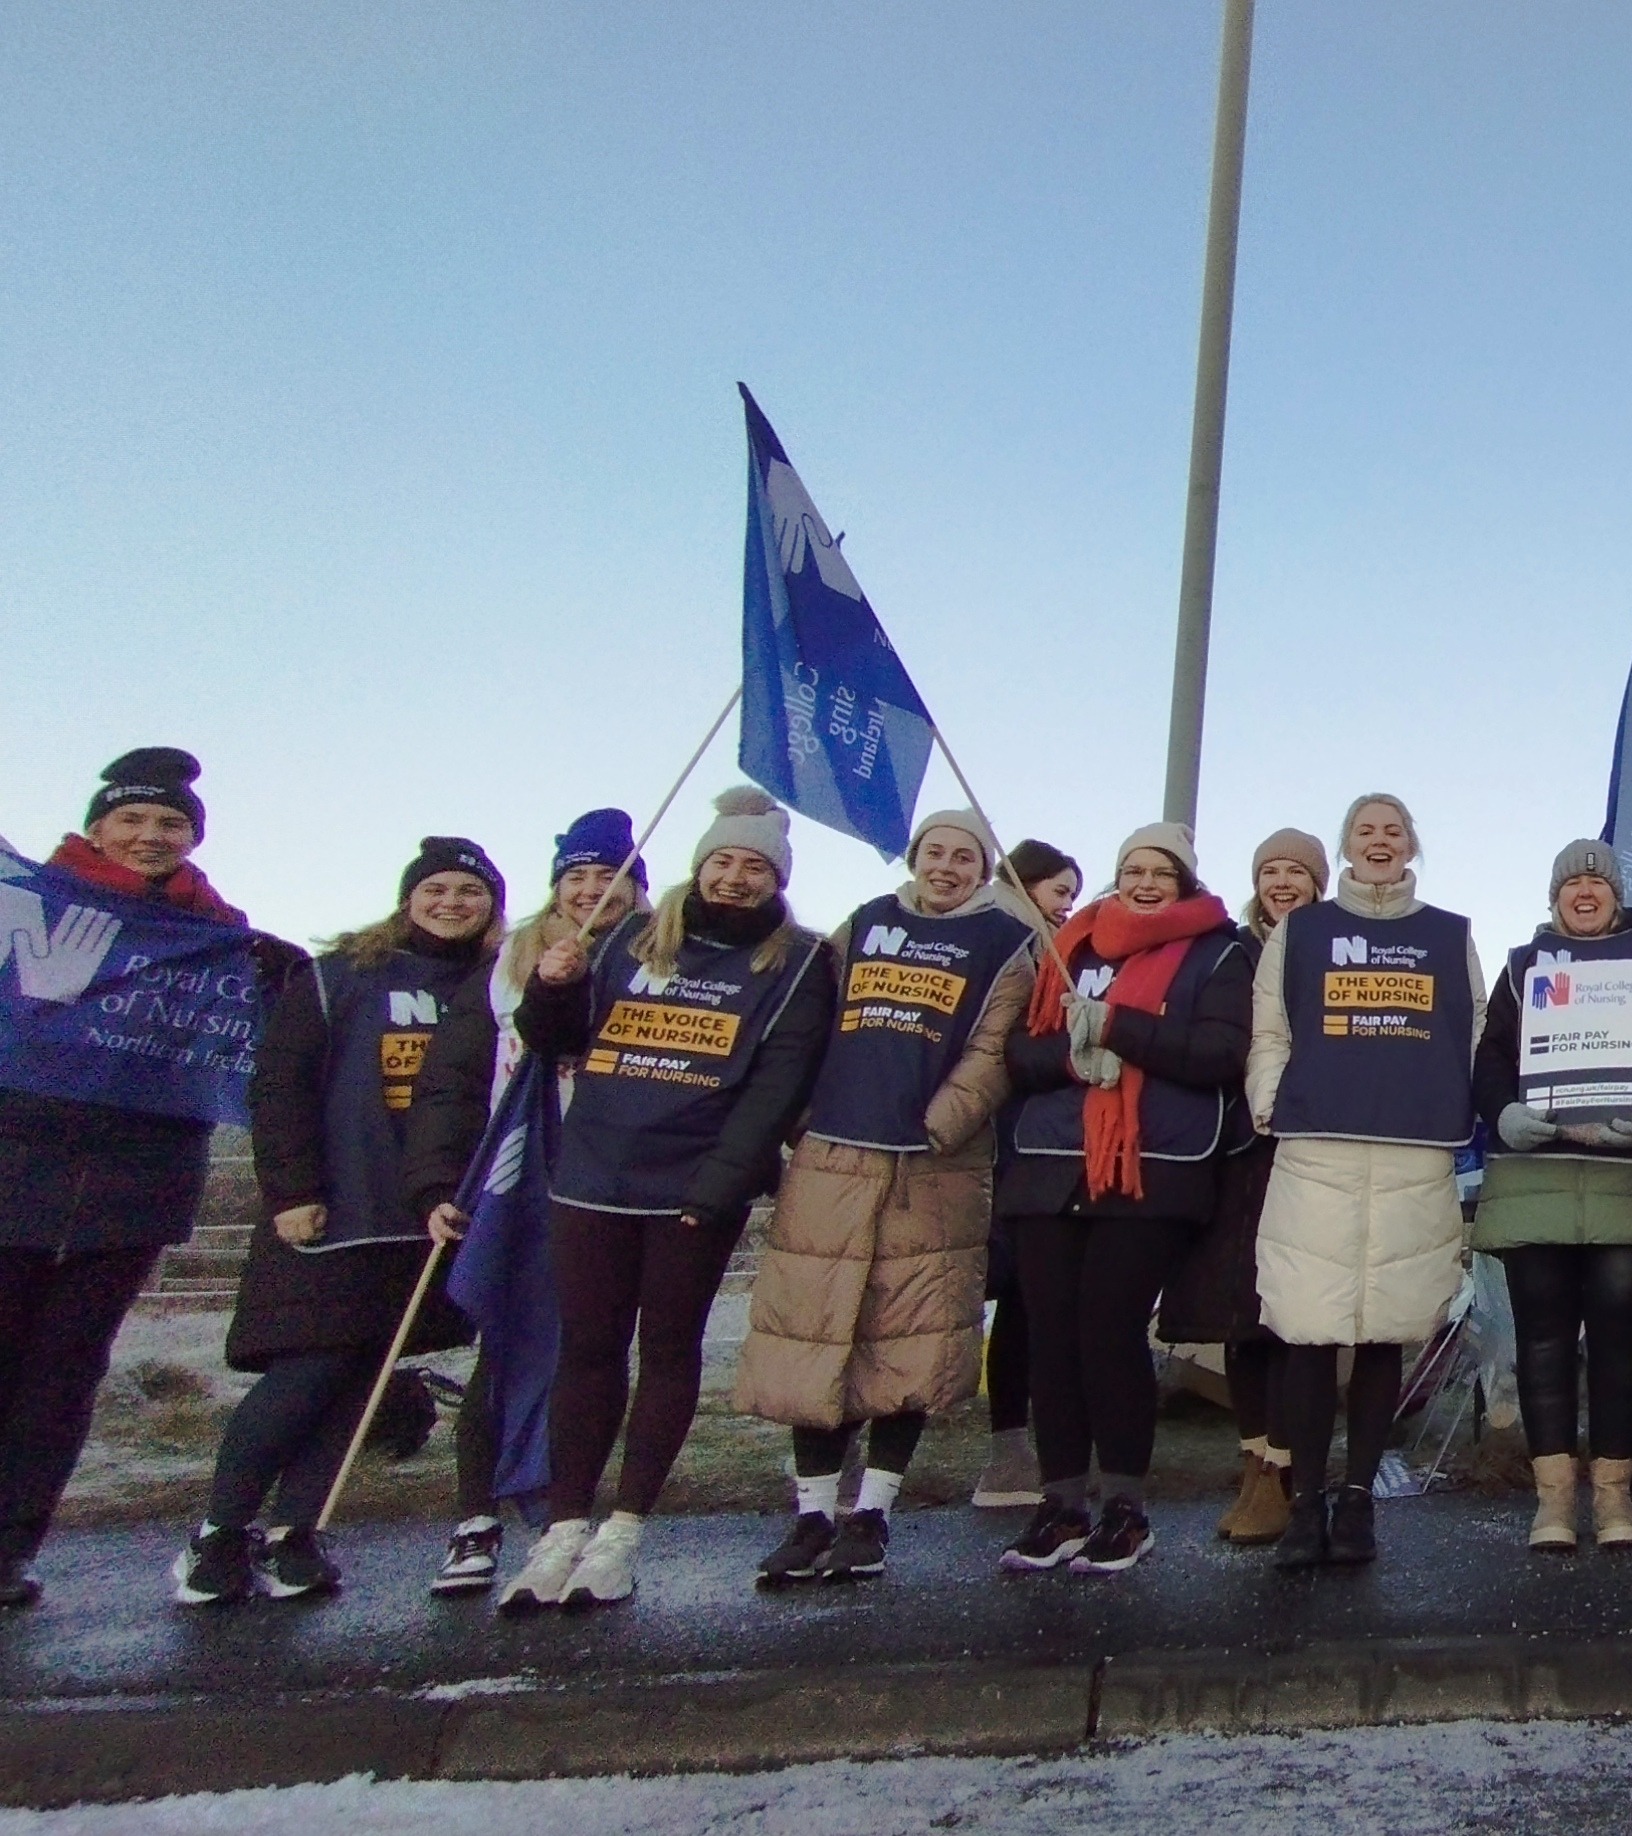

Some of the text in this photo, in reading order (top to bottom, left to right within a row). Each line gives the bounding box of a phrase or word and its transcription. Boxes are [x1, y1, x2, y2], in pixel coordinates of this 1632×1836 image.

[901, 949, 952, 967] of Nursing
[906, 940, 970, 959] Royal College
[1371, 946, 1428, 959] Royal College
[1371, 956, 1416, 969] of Nursing
[671, 973, 742, 994] Royal College
[861, 967, 954, 991] THE VOICE
[1335, 977, 1424, 990] THE VOICE
[665, 986, 722, 1006] of Nursing
[852, 981, 955, 1008] OF NURSING
[1575, 982, 1603, 994] Royal
[101, 990, 145, 1016] of
[1328, 990, 1430, 1005] OF NURSING
[1574, 993, 1627, 1006] of Nursing
[622, 1007, 727, 1032] THE VOICE
[862, 1006, 922, 1022] FAIR PAY
[1352, 1015, 1408, 1026] FAIR PAY
[607, 1023, 730, 1049] OF NURSING
[860, 1017, 942, 1043] FOR NURSNG
[1352, 1026, 1431, 1040] FOR NURSING
[1552, 1030, 1609, 1042] FAIR PAY
[396, 1040, 426, 1052] TH
[1551, 1042, 1577, 1053] FOR
[622, 1053, 691, 1071] FAIR PAY
[618, 1065, 721, 1088] FOR NURSING
